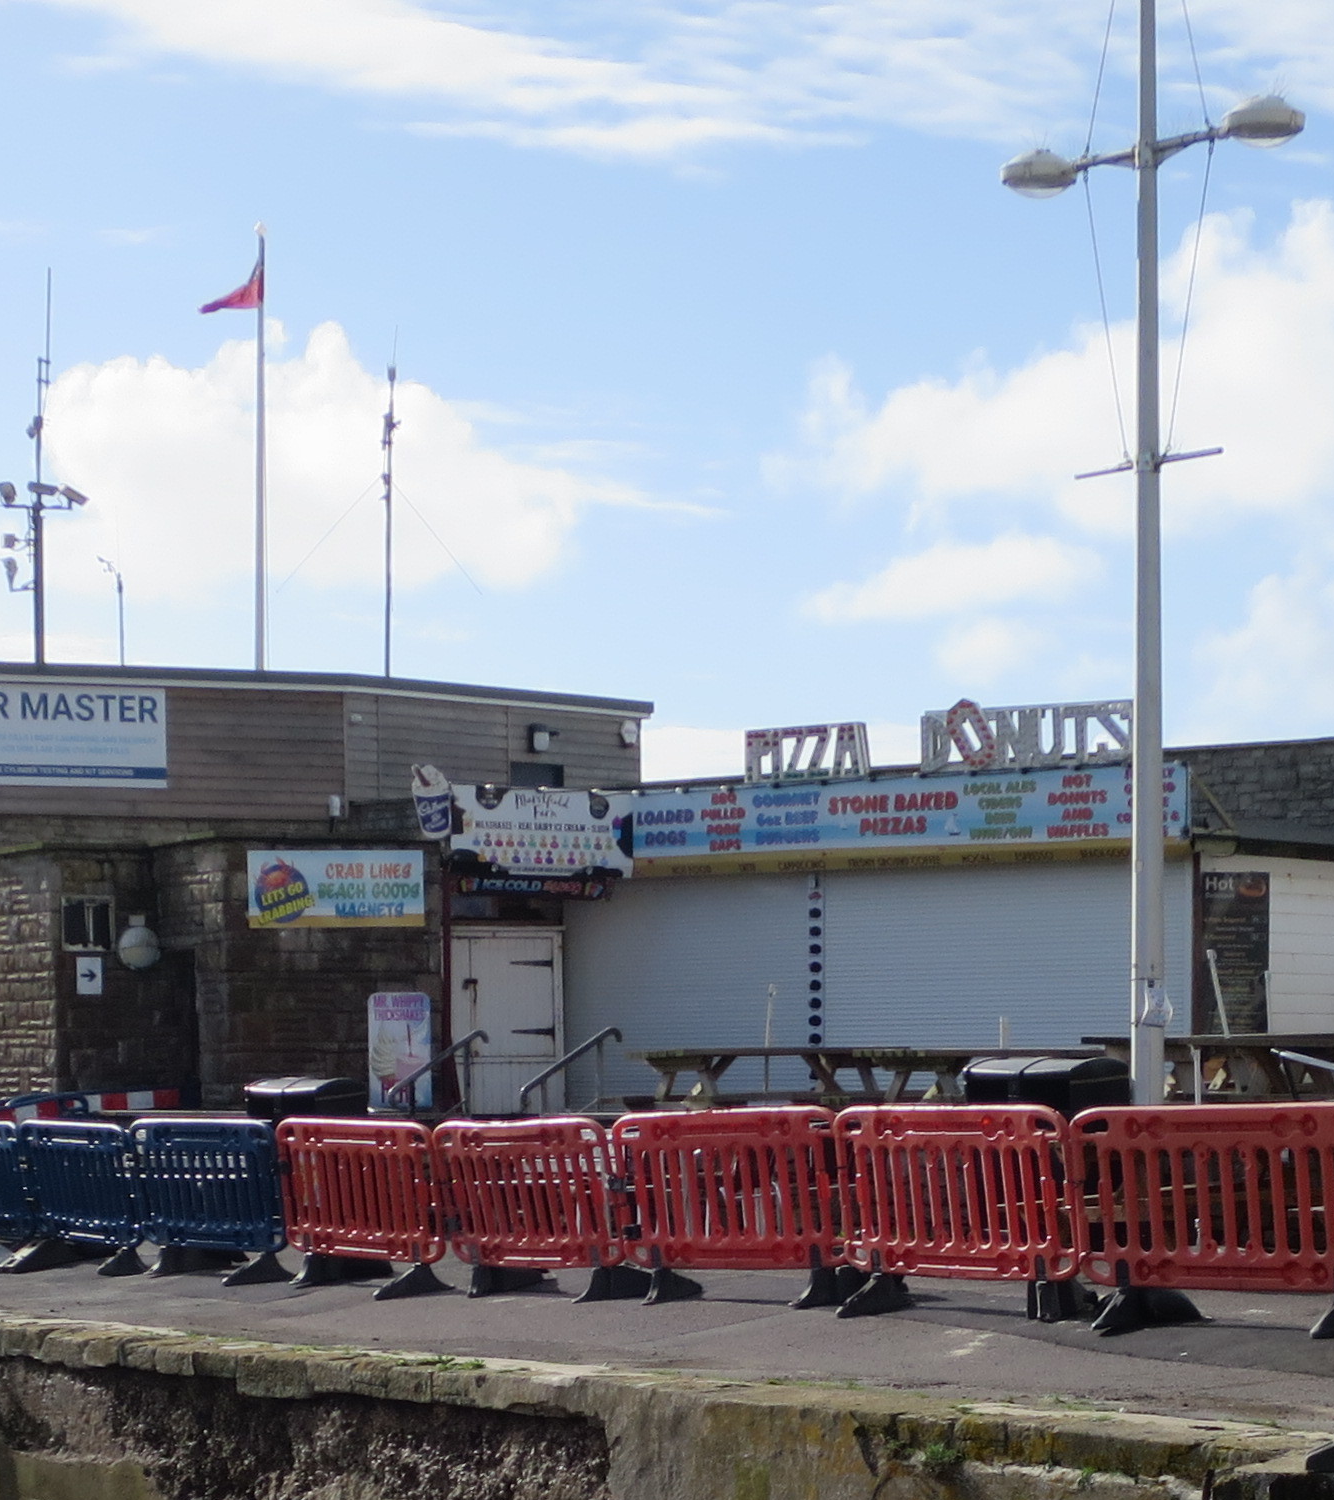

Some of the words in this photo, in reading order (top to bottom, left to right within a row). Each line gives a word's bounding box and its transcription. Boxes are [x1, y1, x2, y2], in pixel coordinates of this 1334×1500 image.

[20, 691, 158, 724] MASTER
[919, 698, 1134, 773] DONUTS
[744, 721, 869, 783] PIZZA
[963, 781, 1001, 796] LOCAL
[1005, 779, 1037, 793] ALES
[1062, 774, 1093, 789] HOT
[710, 791, 737, 805] BBQ
[752, 791, 821, 808] GOURMET
[828, 794, 890, 815] STONE
[893, 790, 959, 812] BAKED
[1047, 789, 1108, 806] DONUTS
[636, 808, 695, 827] LOADED
[700, 807, 746, 821] PULLED
[784, 810, 819, 825] BEEF
[1061, 807, 1094, 821] AND
[706, 823, 742, 836] PORK
[859, 815, 928, 836] PIZZAS
[1046, 823, 1110, 838] WAFFLES
[645, 830, 687, 846] DOGS
[709, 838, 742, 852] BAPS
[755, 828, 821, 846] BURGERS
[325, 862, 364, 879] CRAB
[369, 862, 412, 879] LINES
[287, 882, 303, 896] GO
[317, 882, 367, 899] BEACH
[371, 882, 421, 899] GOODS
[482, 879, 505, 890] ICE
[505, 879, 542, 892] COLD
[1205, 876, 1235, 892] Hot
[334, 902, 405, 918] MAGNETS
